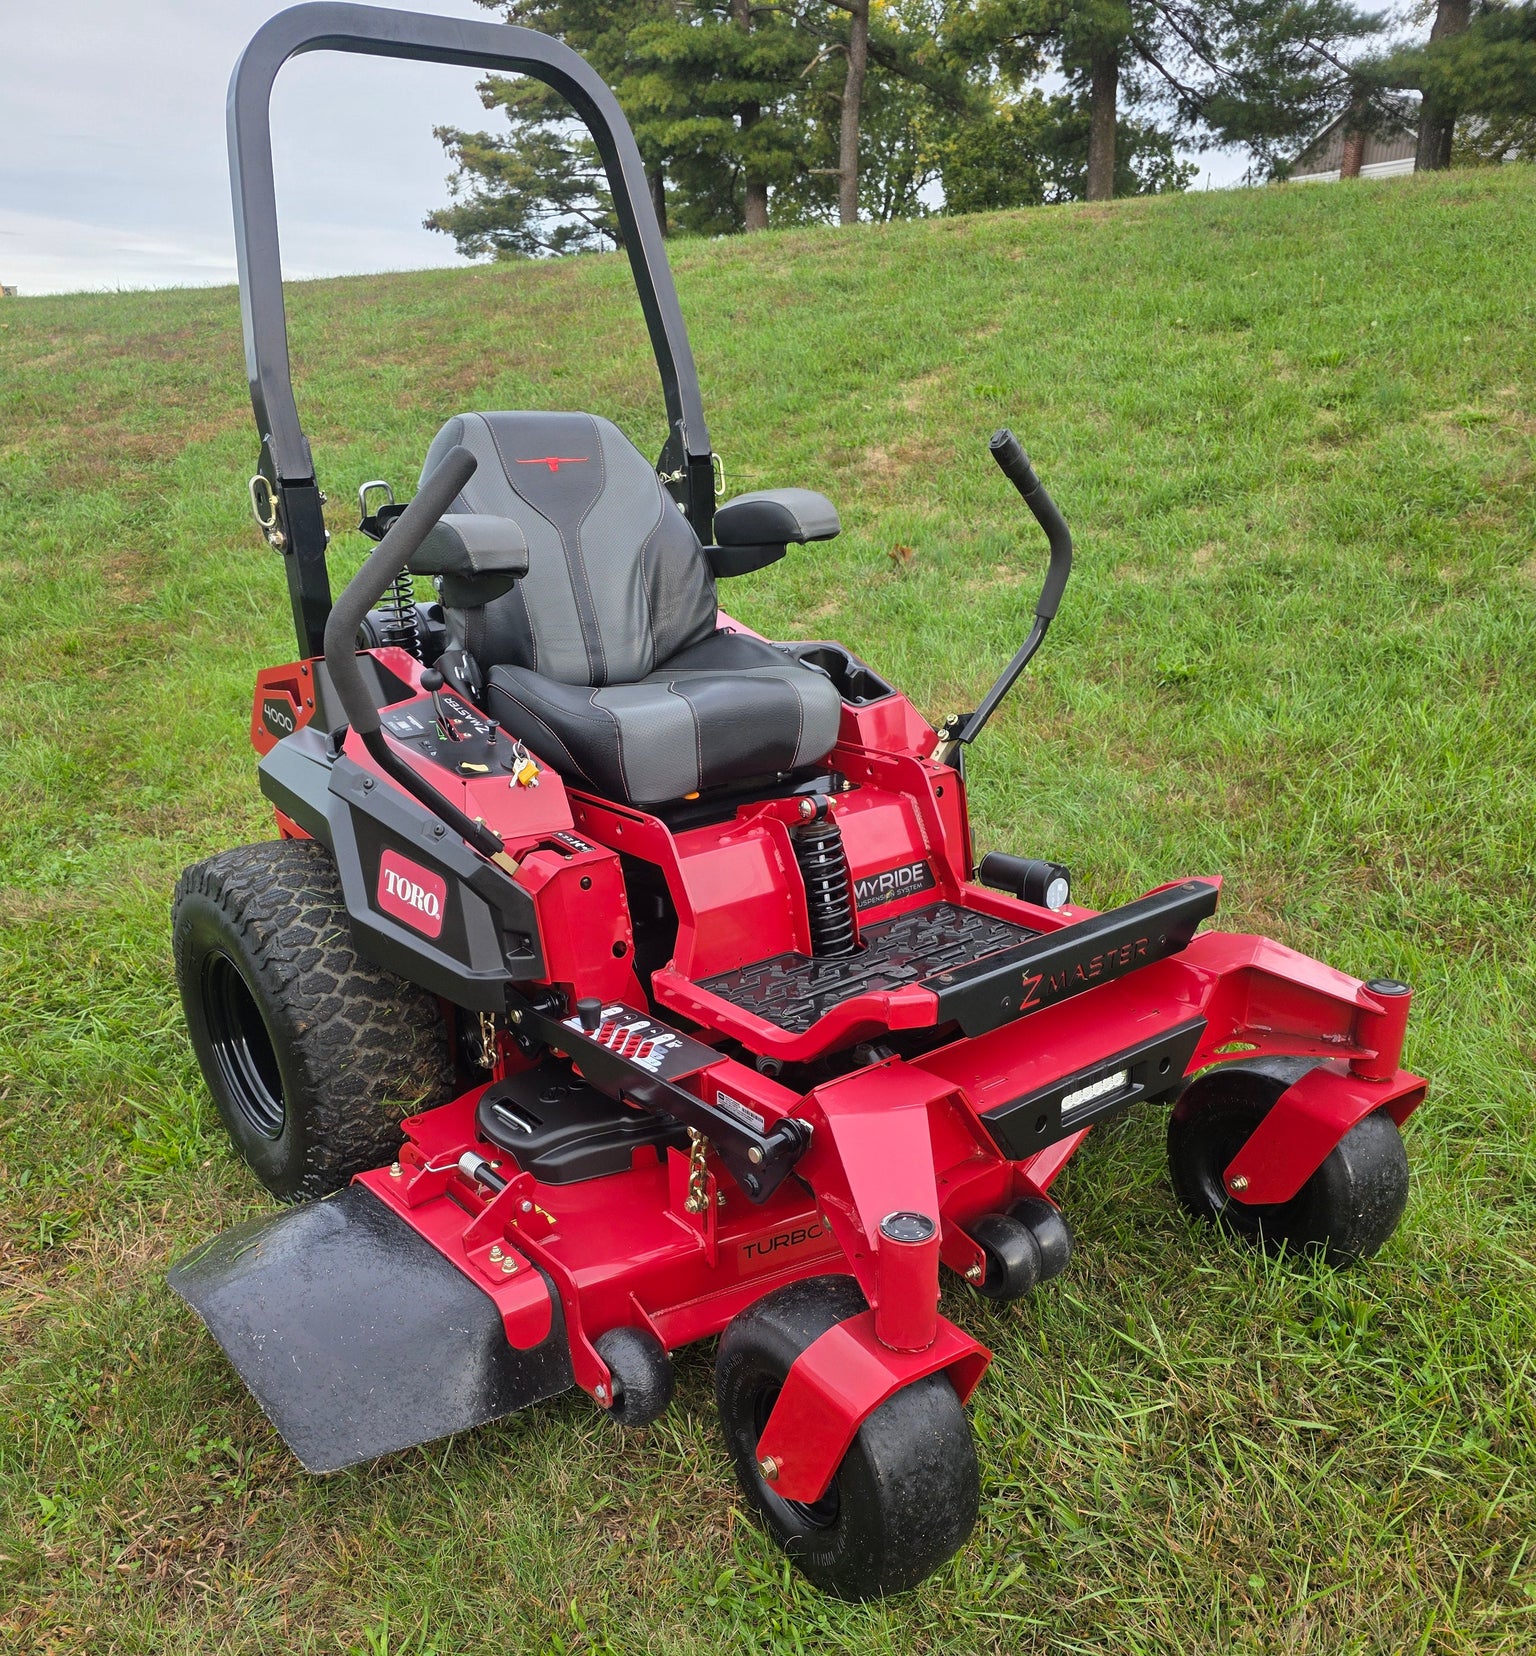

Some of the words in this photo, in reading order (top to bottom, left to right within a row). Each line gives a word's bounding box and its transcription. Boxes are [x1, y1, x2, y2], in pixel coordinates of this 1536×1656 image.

[264, 703, 293, 732] 4000
[443, 696, 484, 727] MASTER
[384, 868, 439, 917] TORO
[896, 883, 923, 896] SYSTEM
[1019, 972, 1045, 1011] Z
[1047, 937, 1150, 994] MASTER
